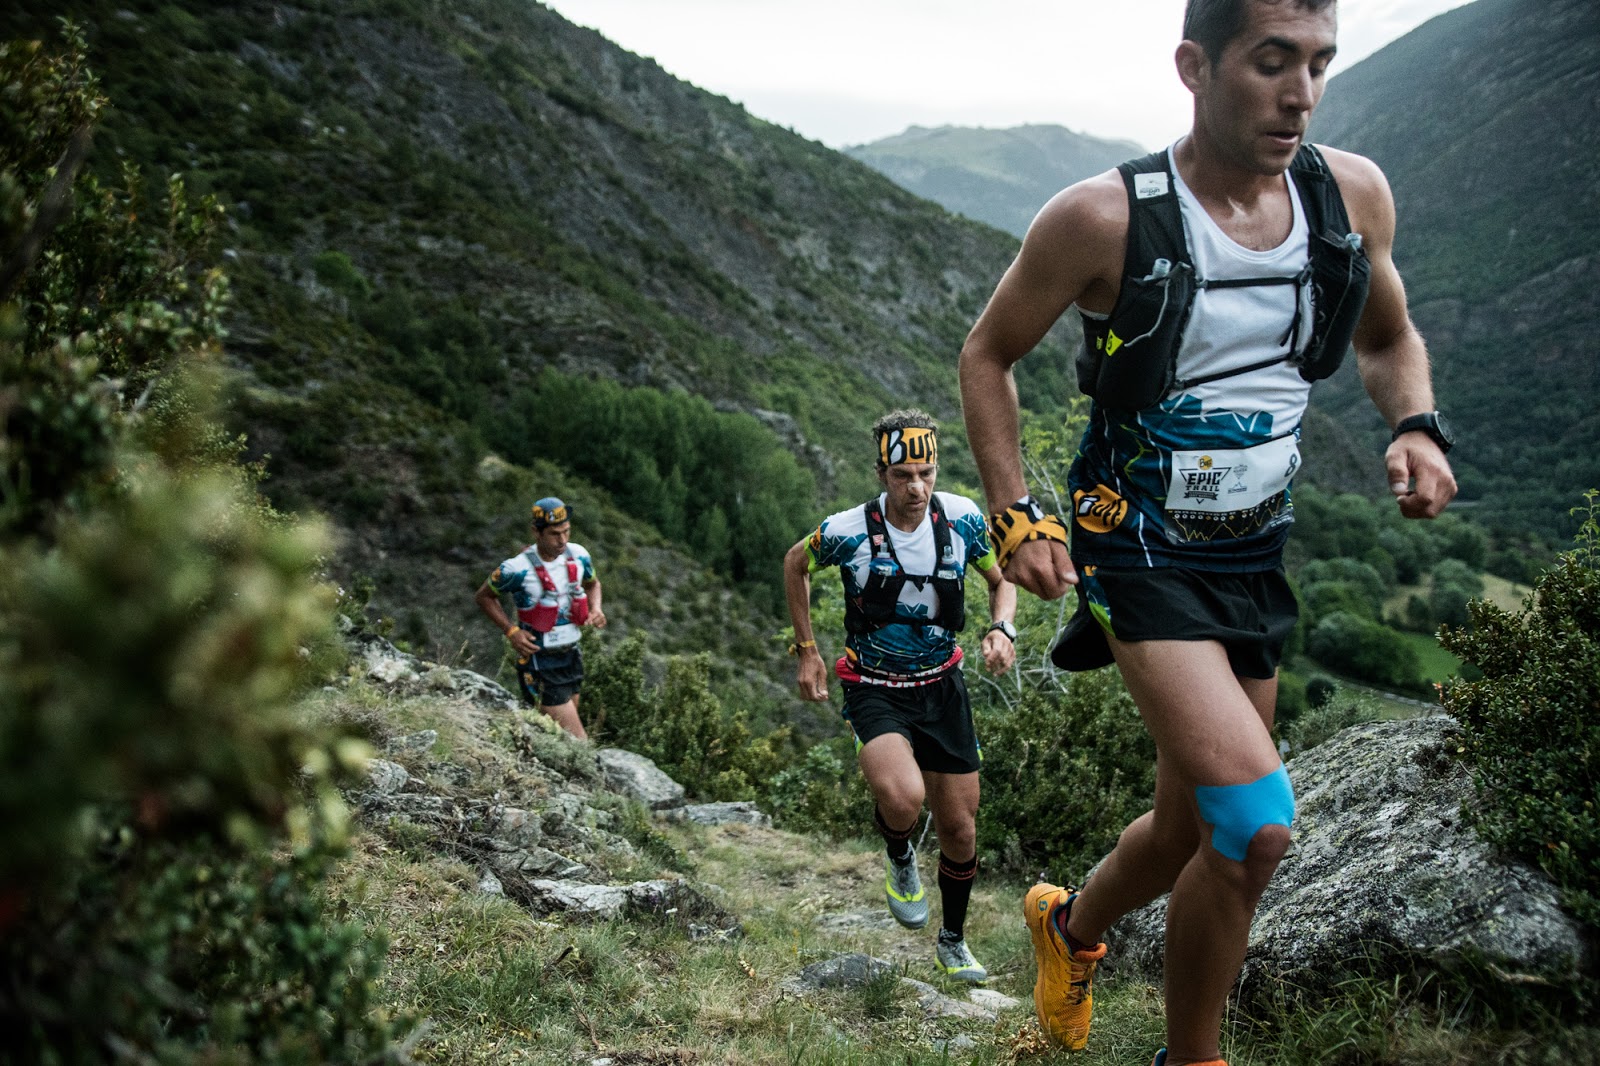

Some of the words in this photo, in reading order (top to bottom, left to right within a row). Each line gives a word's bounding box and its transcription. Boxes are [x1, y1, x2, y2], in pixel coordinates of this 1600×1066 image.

[1284, 453, 1298, 477] 8
[1187, 472, 1222, 485] EPIC
[1076, 494, 1122, 527] Buff
